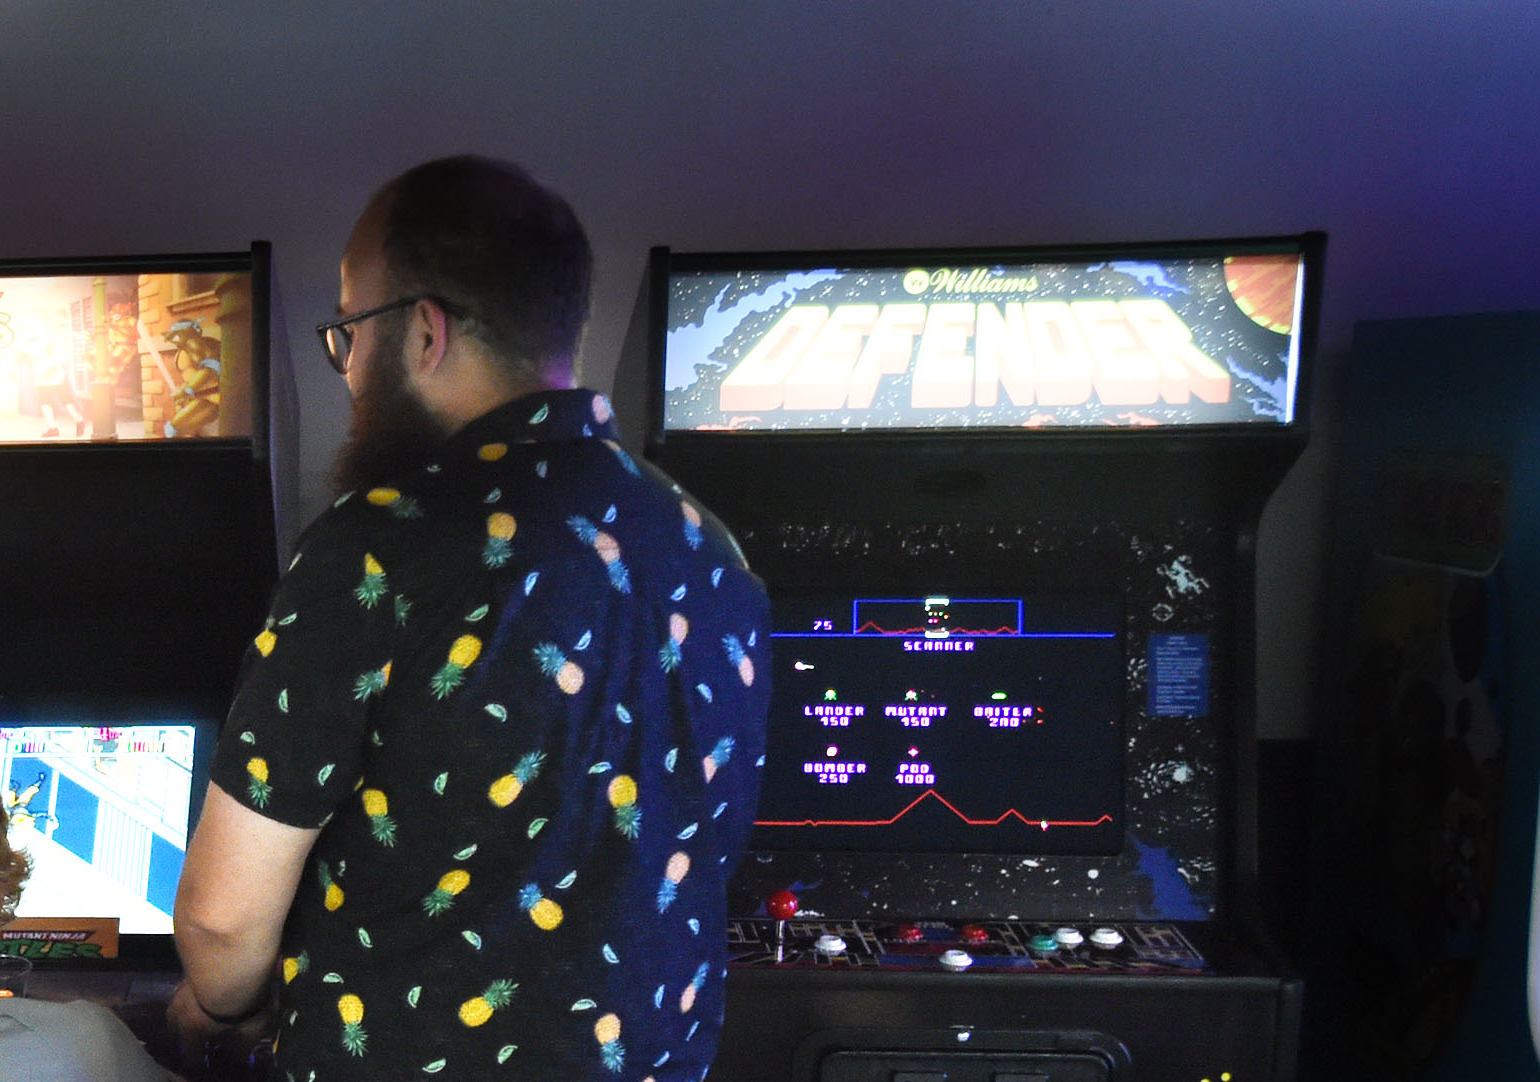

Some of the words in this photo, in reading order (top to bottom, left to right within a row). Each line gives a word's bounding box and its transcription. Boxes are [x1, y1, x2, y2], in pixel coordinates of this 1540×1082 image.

[930, 268, 1038, 293] Williams
[720, 299, 1231, 411] DEFENDER
[813, 620, 833, 631] 75
[903, 641, 975, 651] SCANNER
[804, 705, 865, 716] LANDER
[884, 706, 948, 716] MUTANT
[820, 716, 851, 727] 150
[900, 716, 932, 727] 150
[803, 763, 868, 774] BOMBER
[899, 763, 930, 774] POD
[818, 773, 850, 784] 250
[894, 774, 936, 784] 1000
[2, 932, 47, 940] MUTANT
[48, 932, 87, 941] NINJA
